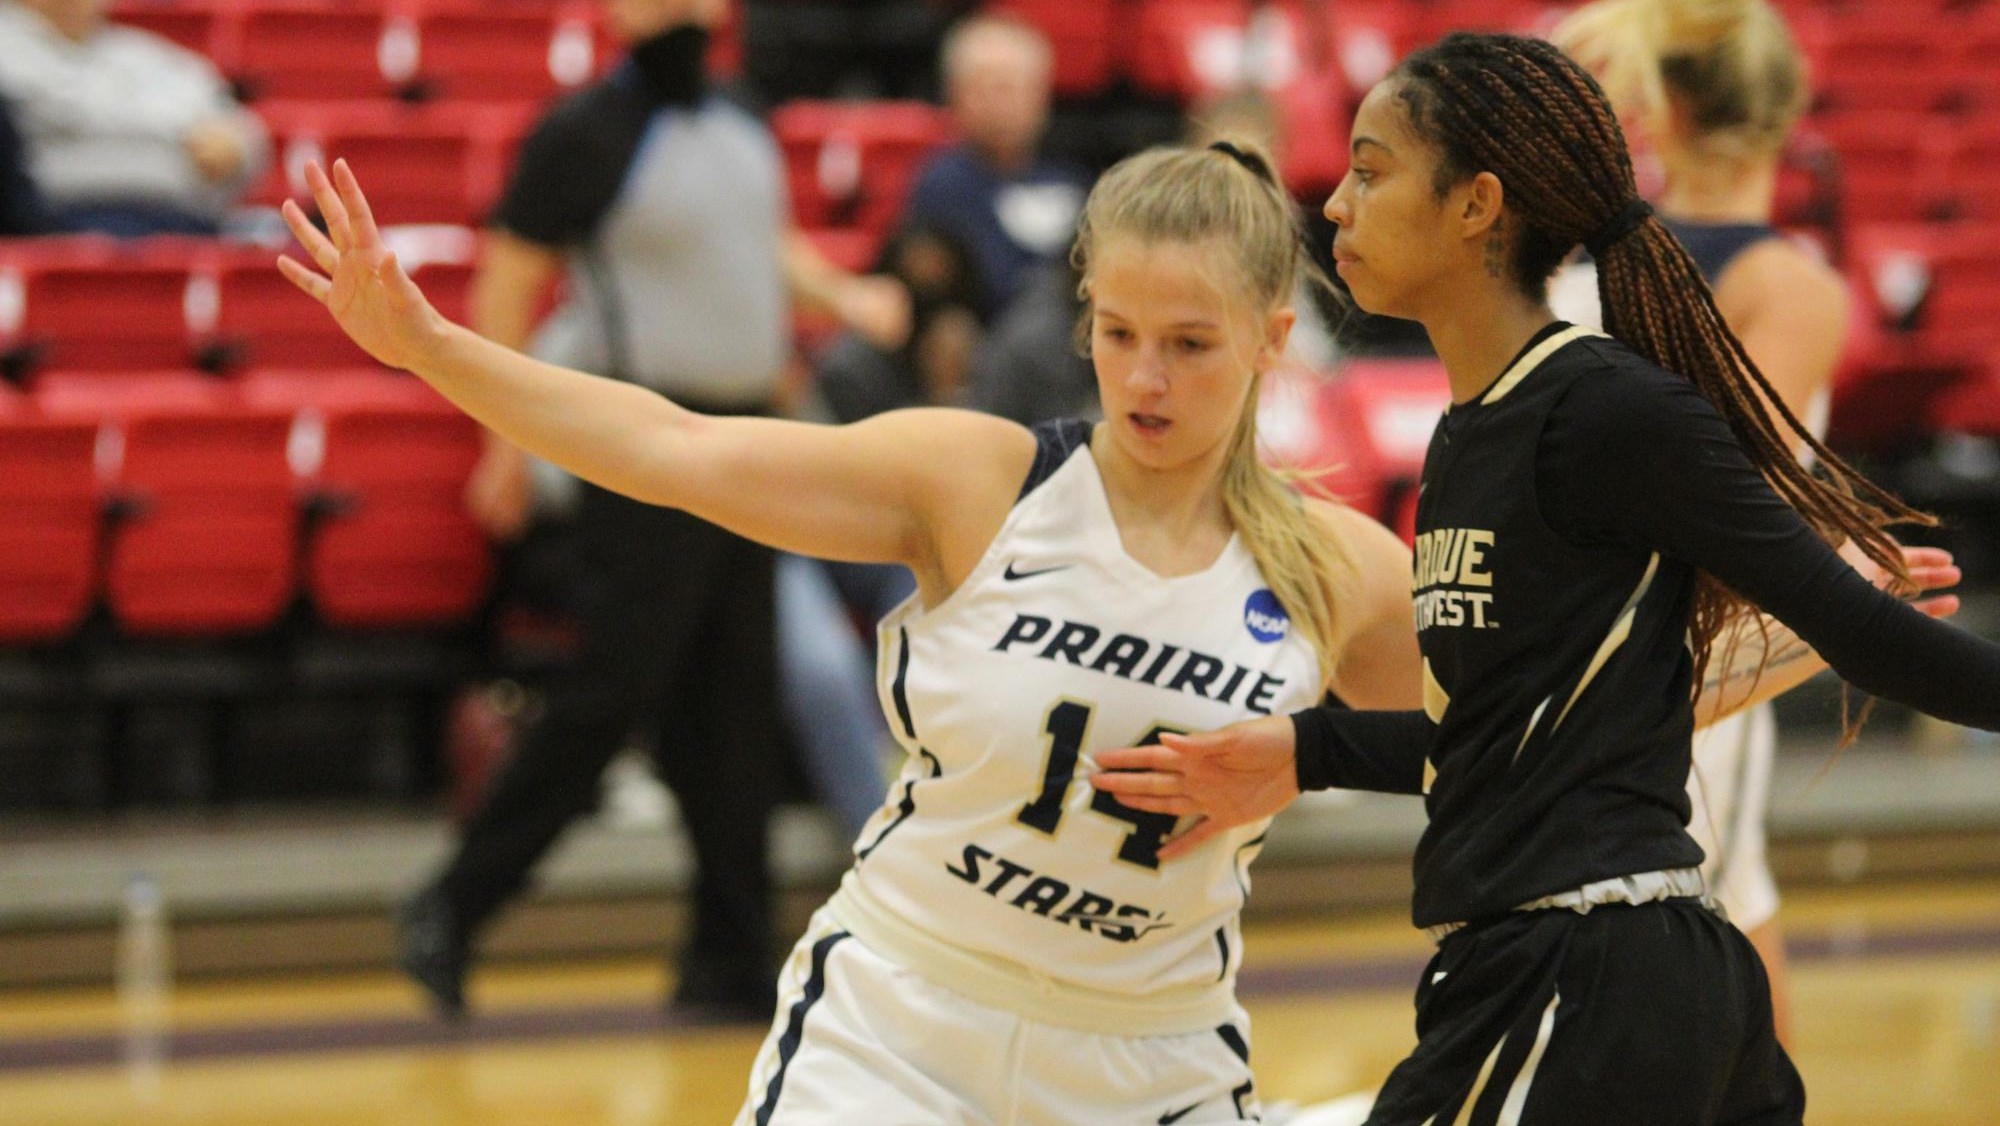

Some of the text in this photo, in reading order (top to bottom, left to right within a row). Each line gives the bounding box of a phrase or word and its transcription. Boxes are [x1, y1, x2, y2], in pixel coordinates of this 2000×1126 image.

[989, 613, 1286, 715] PRAIRIE
[1246, 608, 1290, 636] NCAA
[1010, 695, 1197, 877] 14
[944, 843, 1153, 943] STARS
